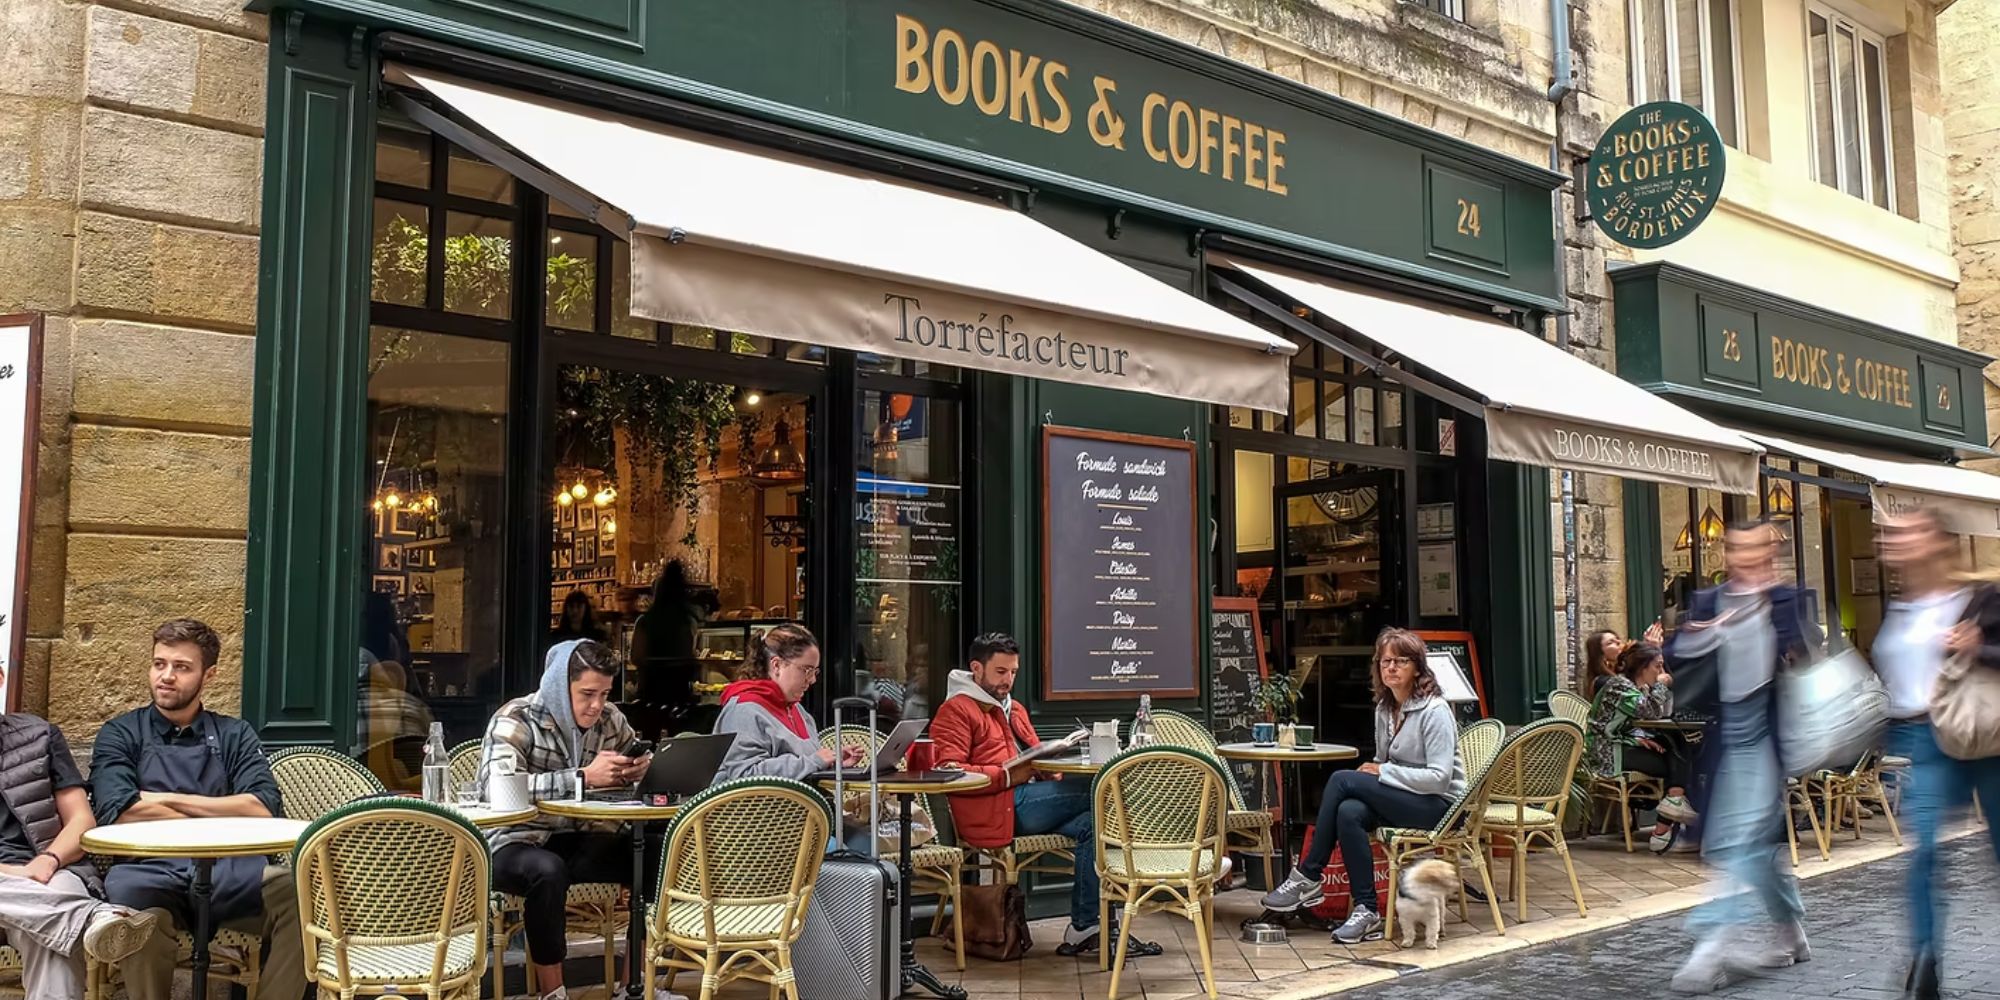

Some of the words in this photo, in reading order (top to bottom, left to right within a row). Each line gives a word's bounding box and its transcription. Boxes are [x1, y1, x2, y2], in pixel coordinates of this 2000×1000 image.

[895, 14, 1072, 134] BOOKS
[1087, 75, 1127, 151] &
[1142, 91, 1289, 196] COFFEE
[1639, 110, 1662, 126] THE
[1613, 119, 1691, 158] BOOKS
[1596, 163, 1613, 189] &
[1618, 143, 1710, 184] COFFEE
[1602, 189, 1708, 240] BORDEAUX
[1615, 191, 1637, 215] RUE
[1661, 178, 1693, 217] JAMES
[1457, 198, 1480, 238] 24
[884, 292, 1130, 377] Torréfacteur
[1771, 335, 1832, 391] BOOKS
[1836, 352, 1851, 395] &
[1855, 357, 1913, 409] COFFEE
[1076, 451, 1117, 473] Formule
[1123, 458, 1166, 477] sandwich
[1555, 428, 1624, 466] BOOKS
[1627, 440, 1641, 468] &
[1644, 442, 1712, 478] COFFEE
[1081, 479, 1122, 500] Formule
[1128, 485, 1159, 503] salade
[1112, 511, 1133, 526] Louis
[1111, 536, 1135, 550] James
[1112, 610, 1136, 629] Daisy
[1111, 636, 1137, 651] Martin
